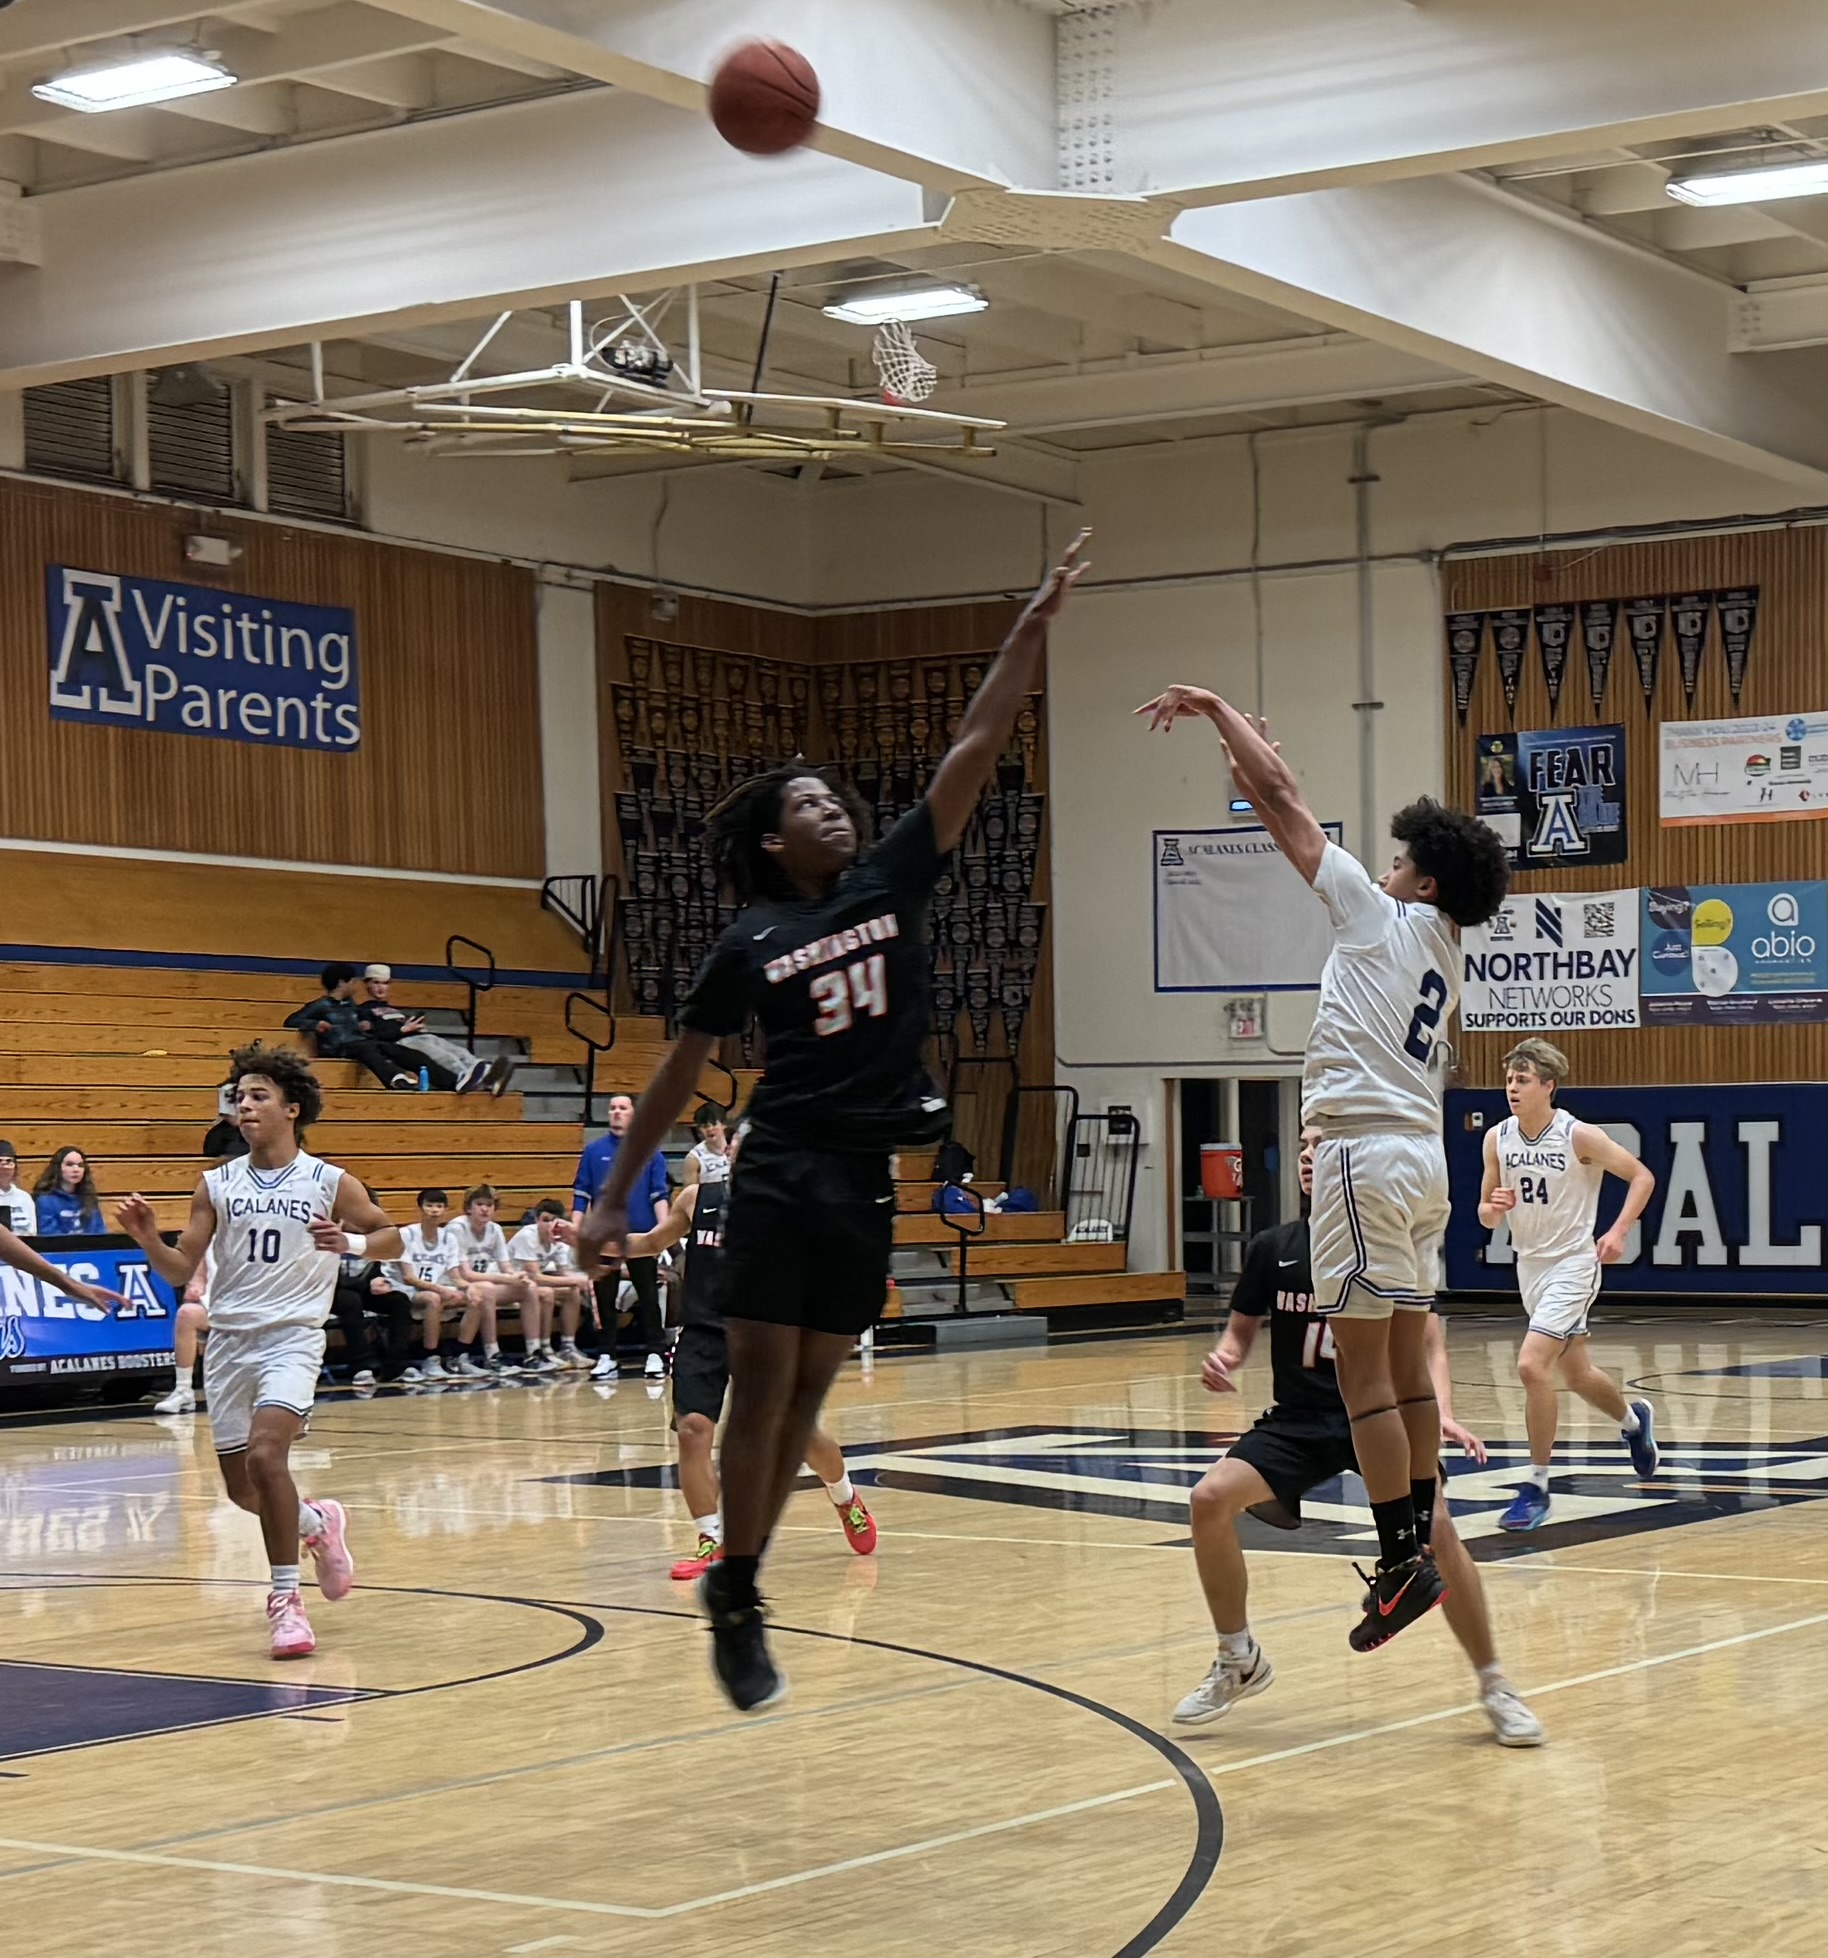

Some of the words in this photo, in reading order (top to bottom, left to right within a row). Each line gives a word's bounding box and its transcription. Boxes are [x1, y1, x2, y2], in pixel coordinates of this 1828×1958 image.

[131, 589, 349, 691] Visiting
[145, 664, 361, 745] Parents
[1528, 744, 1616, 792] FEAR
[1751, 930, 1815, 958] abio
[1464, 948, 1636, 982] NORTHBAY
[809, 953, 887, 1036] 34
[1489, 984, 1612, 1010] NETWORKS
[1404, 968, 1447, 1065] 2
[1466, 1012, 1546, 1028] SUPPORTS
[1550, 1011, 1585, 1026] OUR
[1590, 1009, 1635, 1026] DONS
[1520, 1177, 1548, 1204] 24
[247, 1228, 281, 1263] 10
[117, 1264, 167, 1318] A
